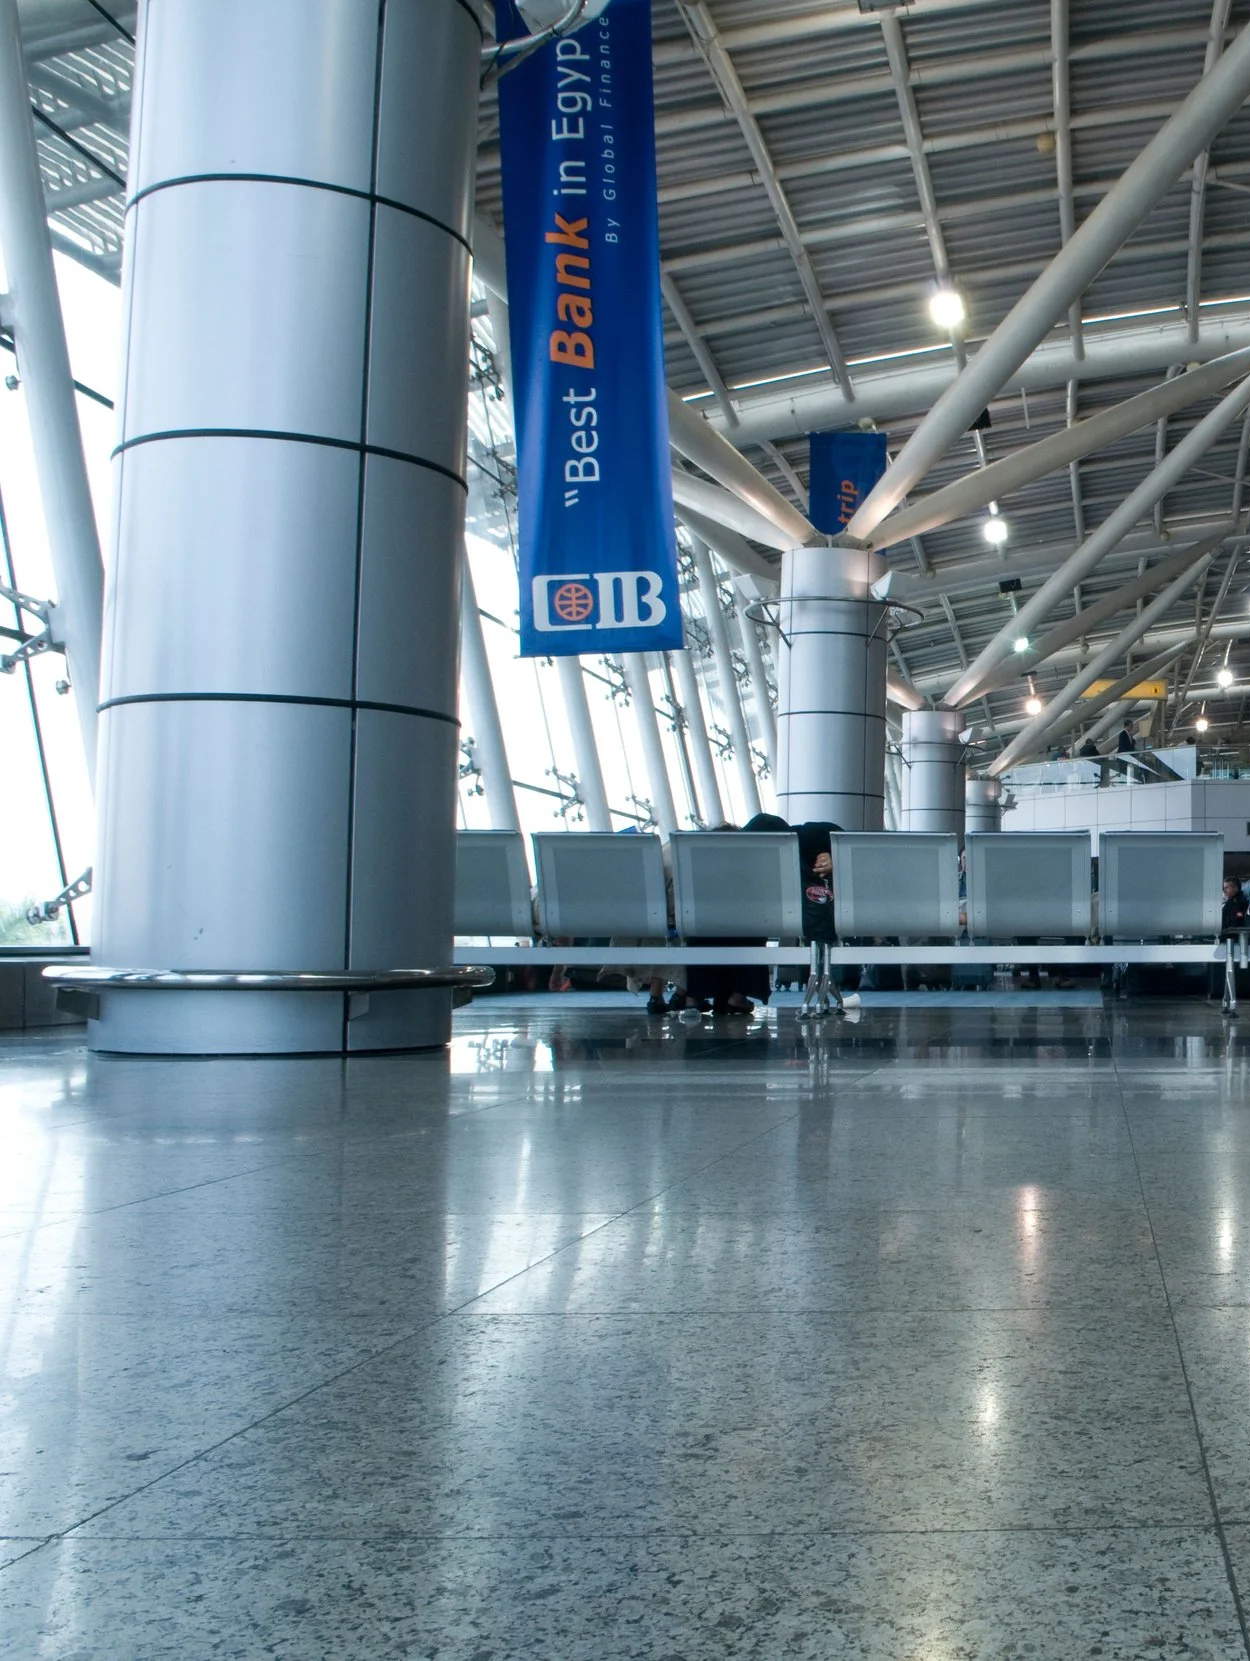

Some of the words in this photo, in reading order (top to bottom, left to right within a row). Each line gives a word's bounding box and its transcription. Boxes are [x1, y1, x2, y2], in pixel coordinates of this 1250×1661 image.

[551, 37, 592, 141] Egyp
[598, 16, 613, 108] Finance
[553, 160, 587, 196] in
[600, 124, 617, 201] Global
[604, 217, 621, 244] By
[544, 212, 595, 370] Bank
[837, 480, 859, 524] trip
[532, 570, 667, 632] CIB
